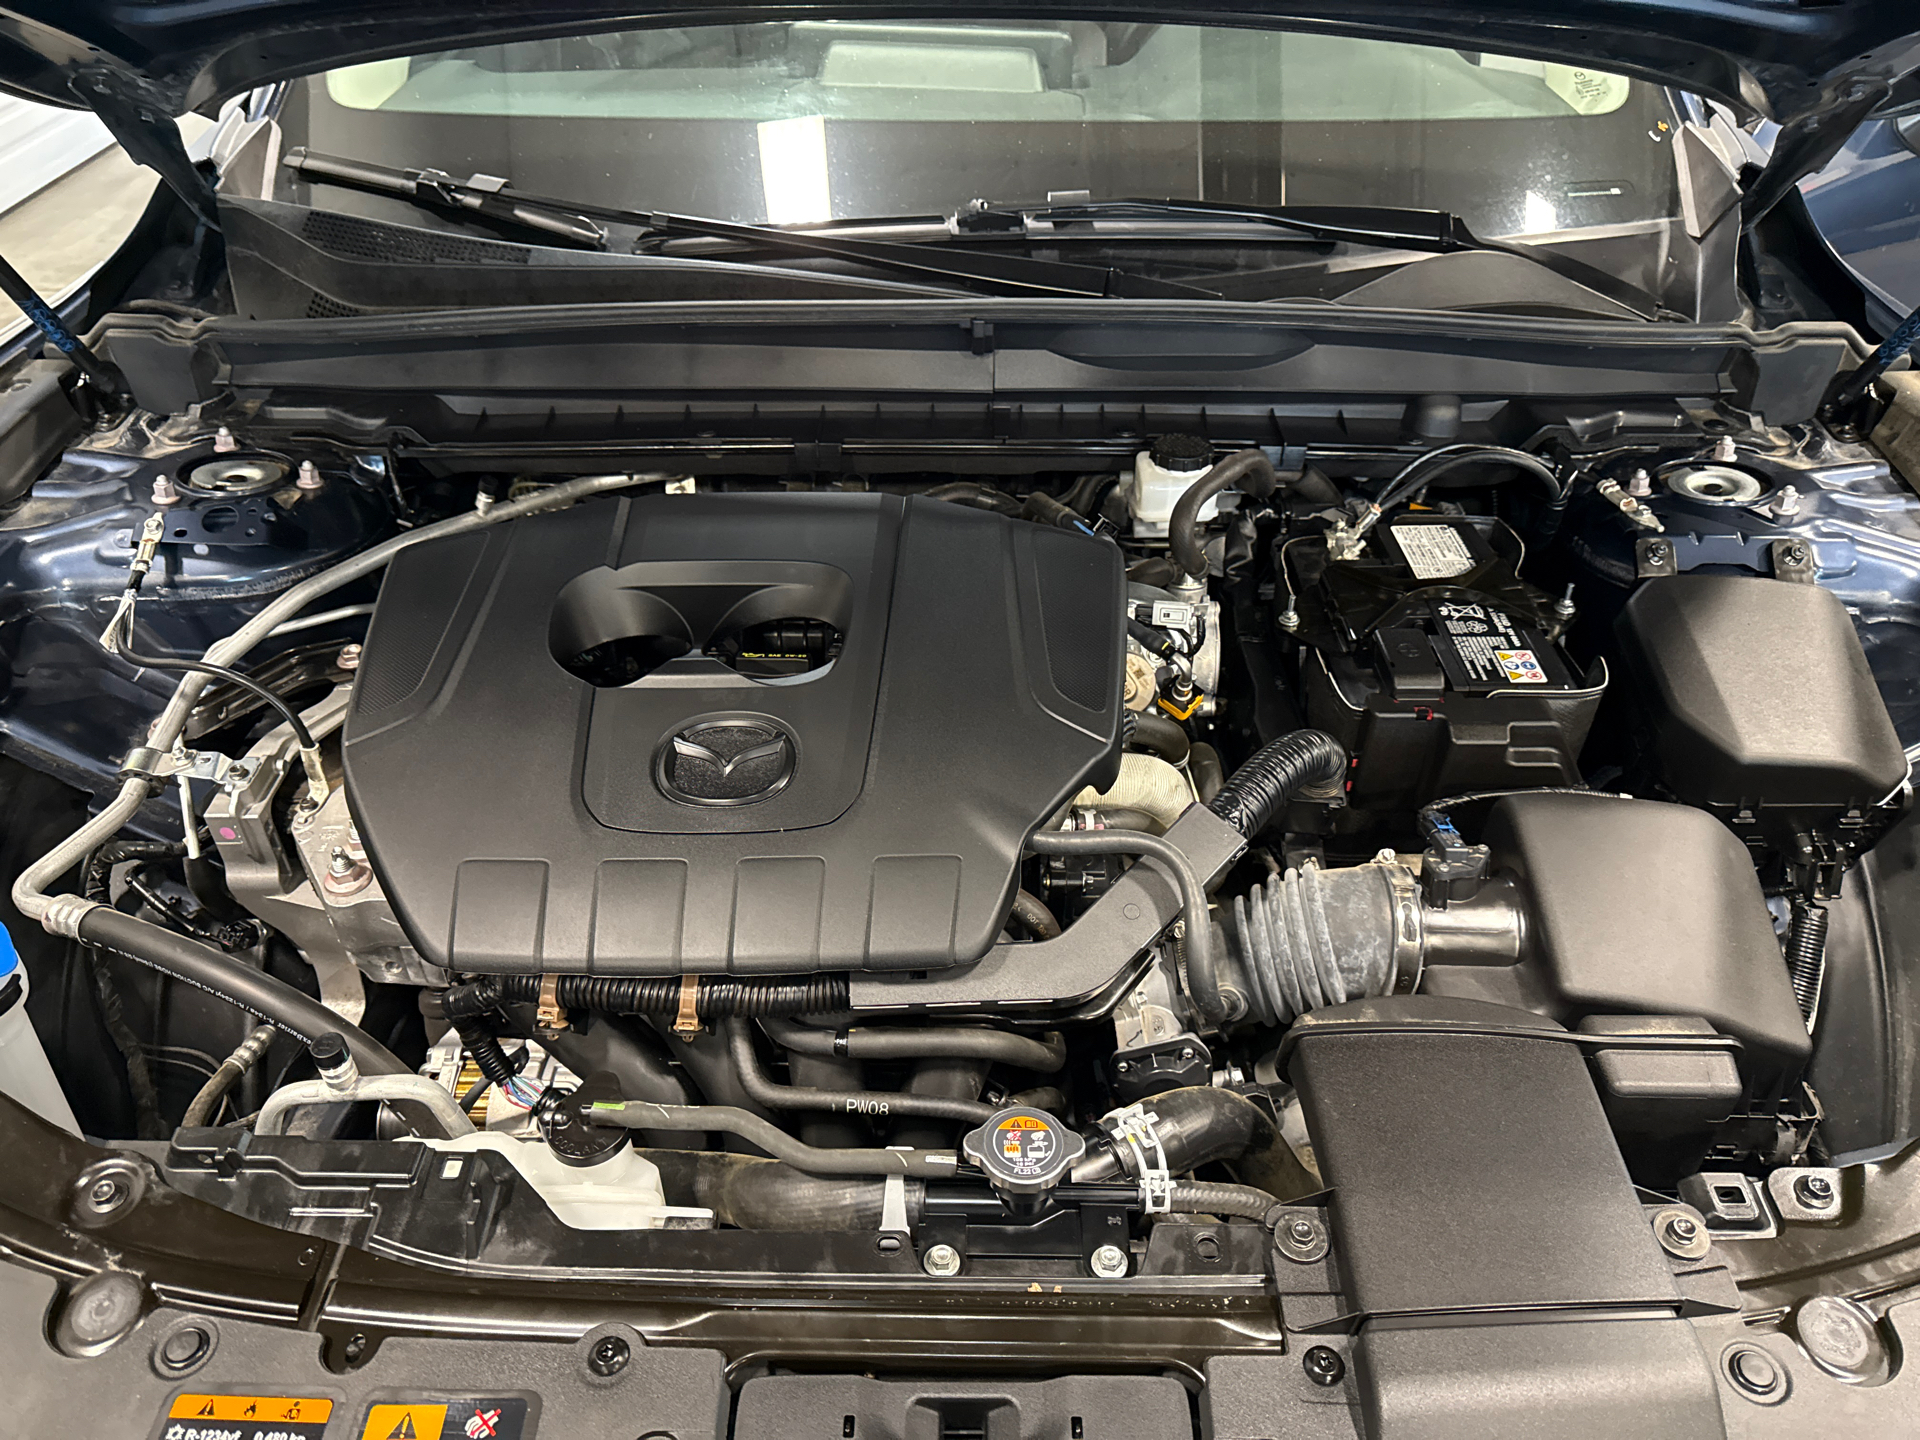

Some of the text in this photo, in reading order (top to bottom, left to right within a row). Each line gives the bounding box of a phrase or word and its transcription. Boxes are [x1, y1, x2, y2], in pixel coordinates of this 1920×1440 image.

[277, 1022, 312, 1045] exBarrier
[846, 1098, 889, 1116] PW08
[554, 1135, 608, 1156] COOLANT
